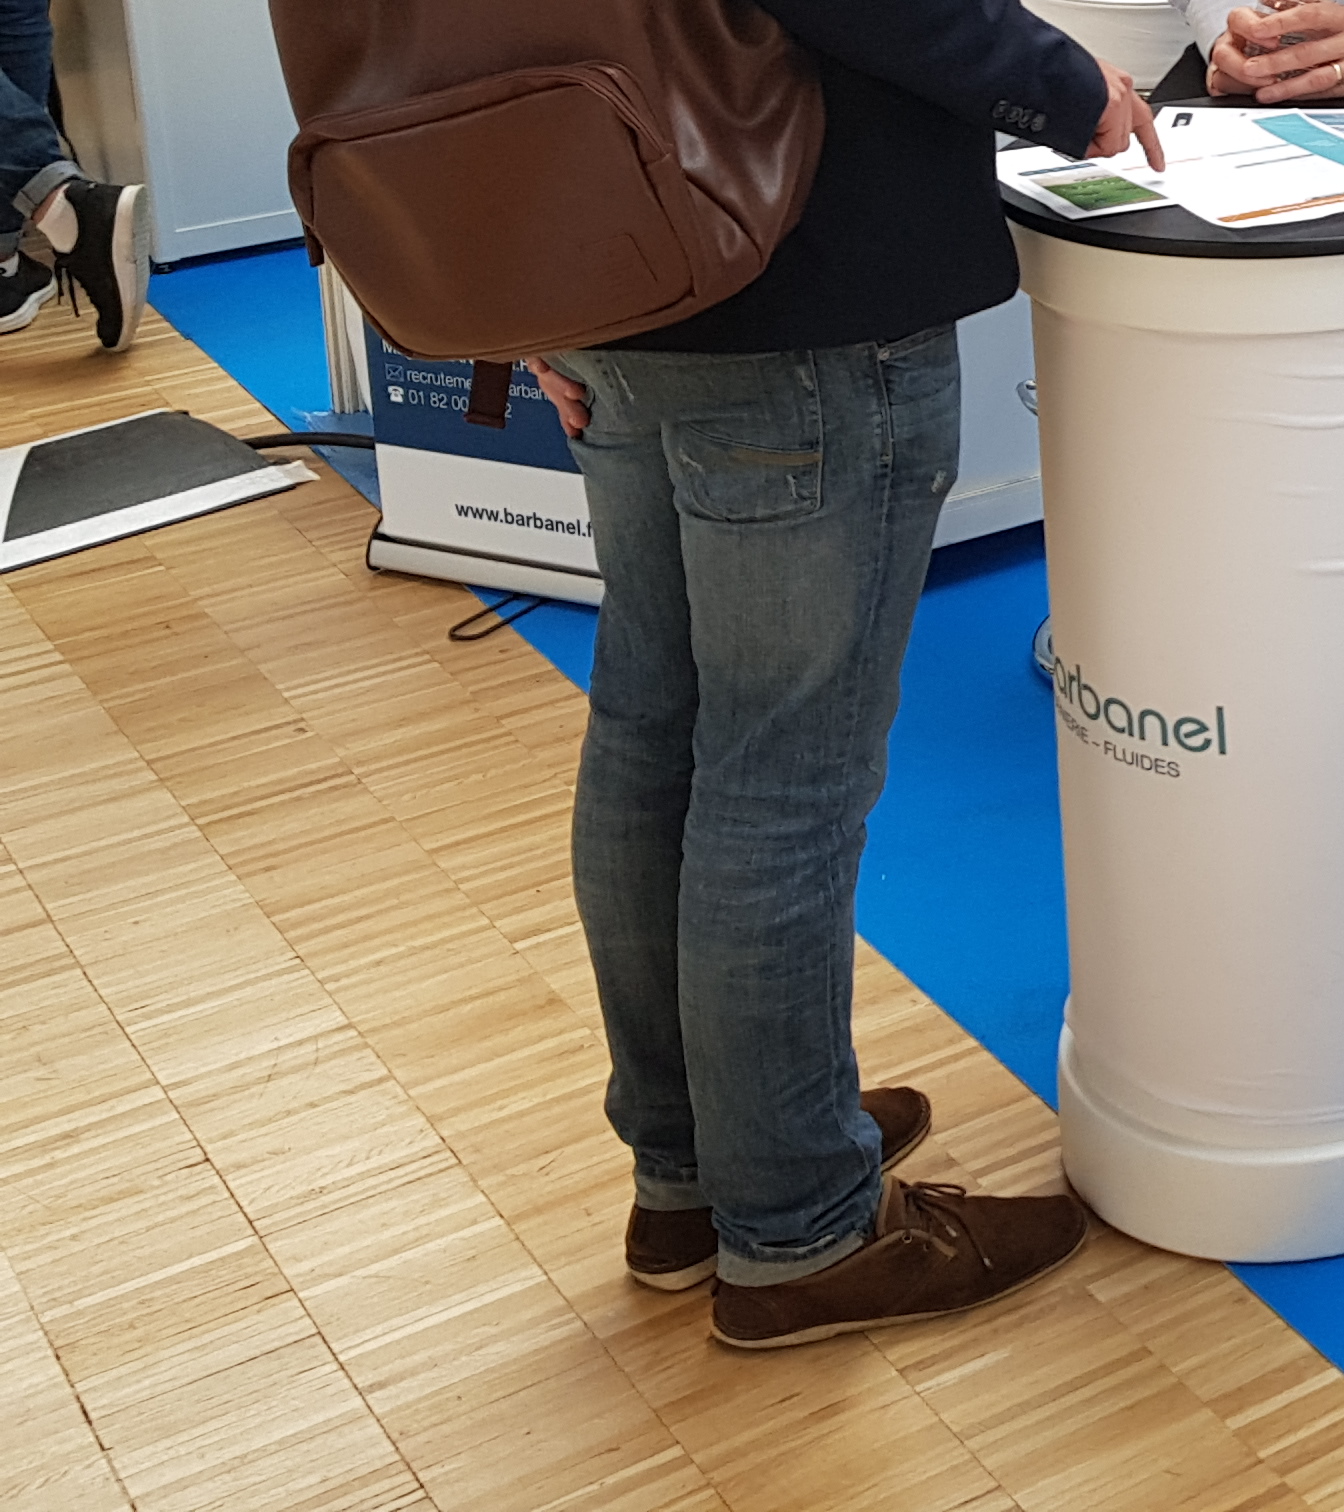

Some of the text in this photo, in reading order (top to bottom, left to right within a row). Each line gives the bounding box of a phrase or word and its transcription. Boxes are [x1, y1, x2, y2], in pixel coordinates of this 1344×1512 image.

[408, 389, 426, 405] 01
[430, 393, 448, 408] 82
[1053, 655, 1227, 755] arbanel
[1103, 739, 1181, 778] FLUIDES
